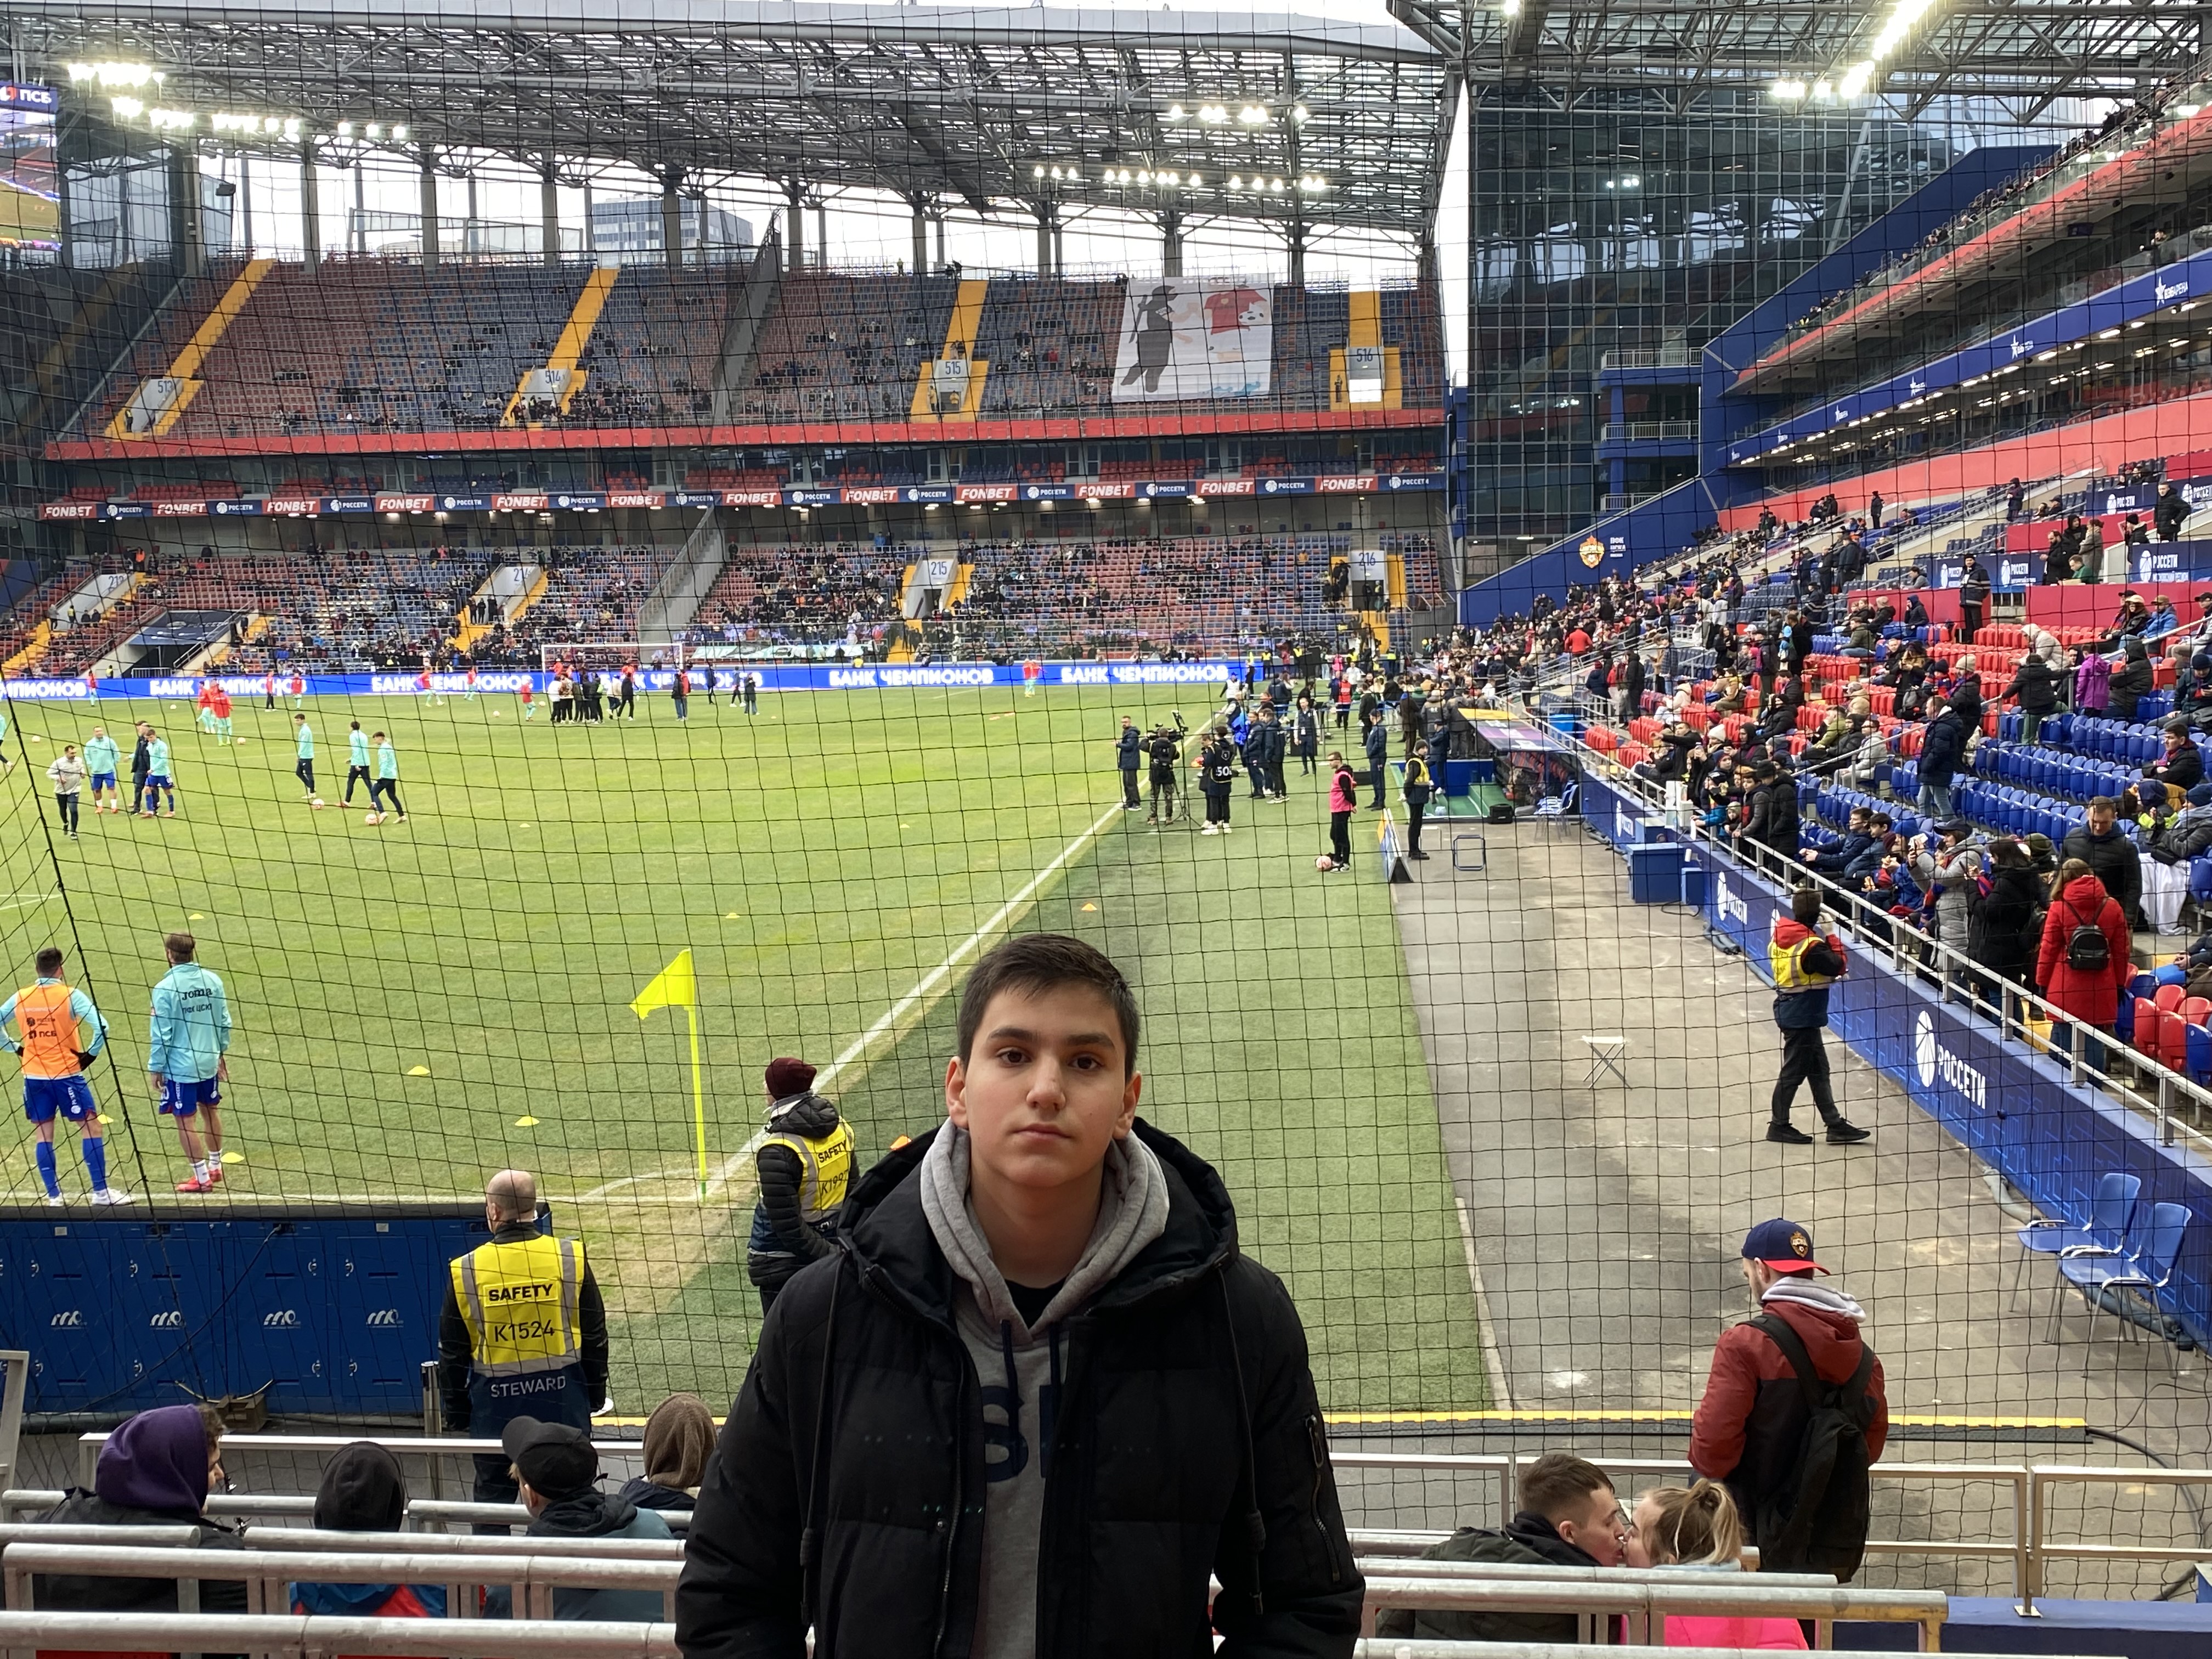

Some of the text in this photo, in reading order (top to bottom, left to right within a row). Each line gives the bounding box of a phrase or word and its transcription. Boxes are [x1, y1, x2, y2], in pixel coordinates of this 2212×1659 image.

[20, 89, 52, 104] ПСБ
[1357, 348, 1373, 362] 516
[945, 361, 961, 375] 515
[1079, 484, 1130, 497] FONBET
[1200, 481, 1254, 494] FONBET
[1319, 478, 1373, 490] FONBET
[611, 495, 661, 505] FONBET
[726, 492, 776, 504] FONBET
[845, 489, 897, 501] FONBET
[961, 487, 1012, 499] FONBET
[267, 501, 315, 512] FONBET
[380, 498, 430, 510] FONBET
[496, 496, 548, 507] FONBET
[44, 506, 92, 517] FONBET
[157, 503, 206, 515] FONBET
[1359, 552, 1375, 566] 216
[2153, 554, 2178, 568] РОССЕТИ
[931, 561, 947, 575] 215
[830, 669, 994, 686] БАНК ЧЕМПИОНОВ
[1061, 665, 1228, 683] БАНК ЧЕМПИОНОВ
[150, 680, 194, 695] БАНК
[371, 676, 417, 692] БАНК
[1215, 766, 1232, 776] 50
[1727, 890, 1747, 925] РОССЕТИ
[1937, 1043, 1986, 1110] РОССЕТИ
[818, 1139, 847, 1163] SAFETY
[489, 1284, 553, 1301] SAFETY
[494, 1319, 555, 1342] K1524
[490, 1375, 566, 1397] STEWARD
